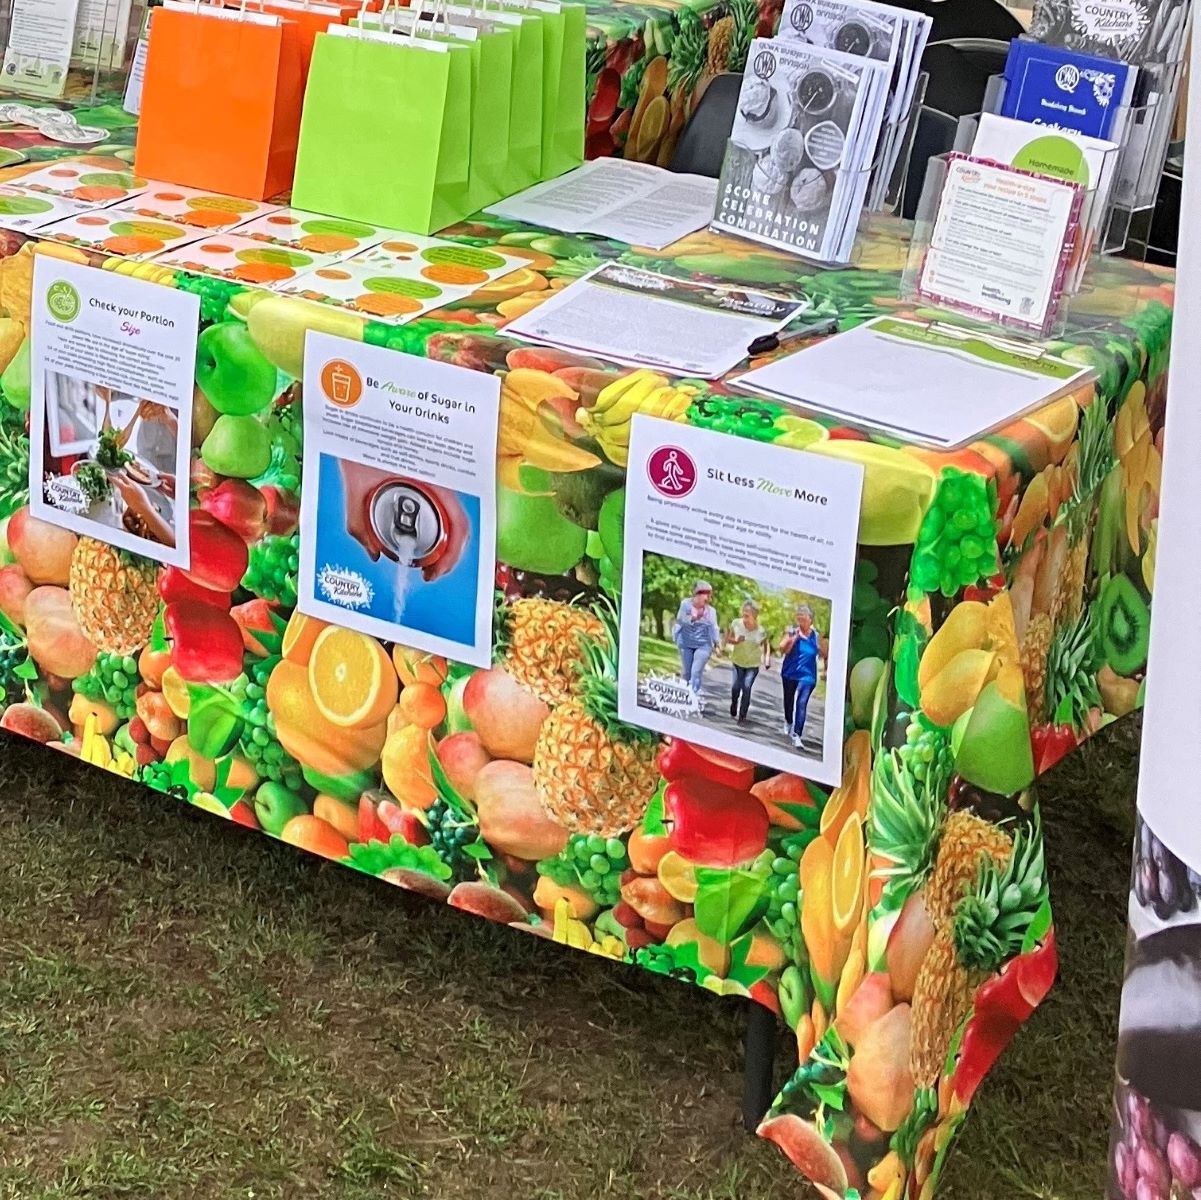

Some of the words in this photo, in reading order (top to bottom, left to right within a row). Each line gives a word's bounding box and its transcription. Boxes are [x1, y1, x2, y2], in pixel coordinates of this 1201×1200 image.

[1085, 5, 1132, 19] COUNTRY
[1094, 18, 1134, 28] Kitchens
[1029, 159, 1074, 175] Homemade
[725, 183, 770, 205] SCONE
[722, 197, 819, 235] CELEBRATION
[719, 212, 816, 250] COMPILATION
[89, 298, 116, 312] Check
[118, 306, 138, 318] your
[140, 310, 174, 328] Portion
[120, 321, 140, 336] Size
[366, 377, 379, 388] Be
[418, 392, 429, 400] of
[431, 394, 462, 410] Sugar
[465, 401, 475, 413] in
[389, 400, 412, 415] Your
[415, 407, 449, 424] Drinks
[51, 483, 80, 498] COUNTRY
[707, 468, 724, 481] Sit
[727, 473, 754, 488] Less
[756, 478, 792, 497] Move
[794, 489, 828, 505] More
[325, 576, 359, 591] COUNTRY
[649, 682, 689, 699] COUNTRY
